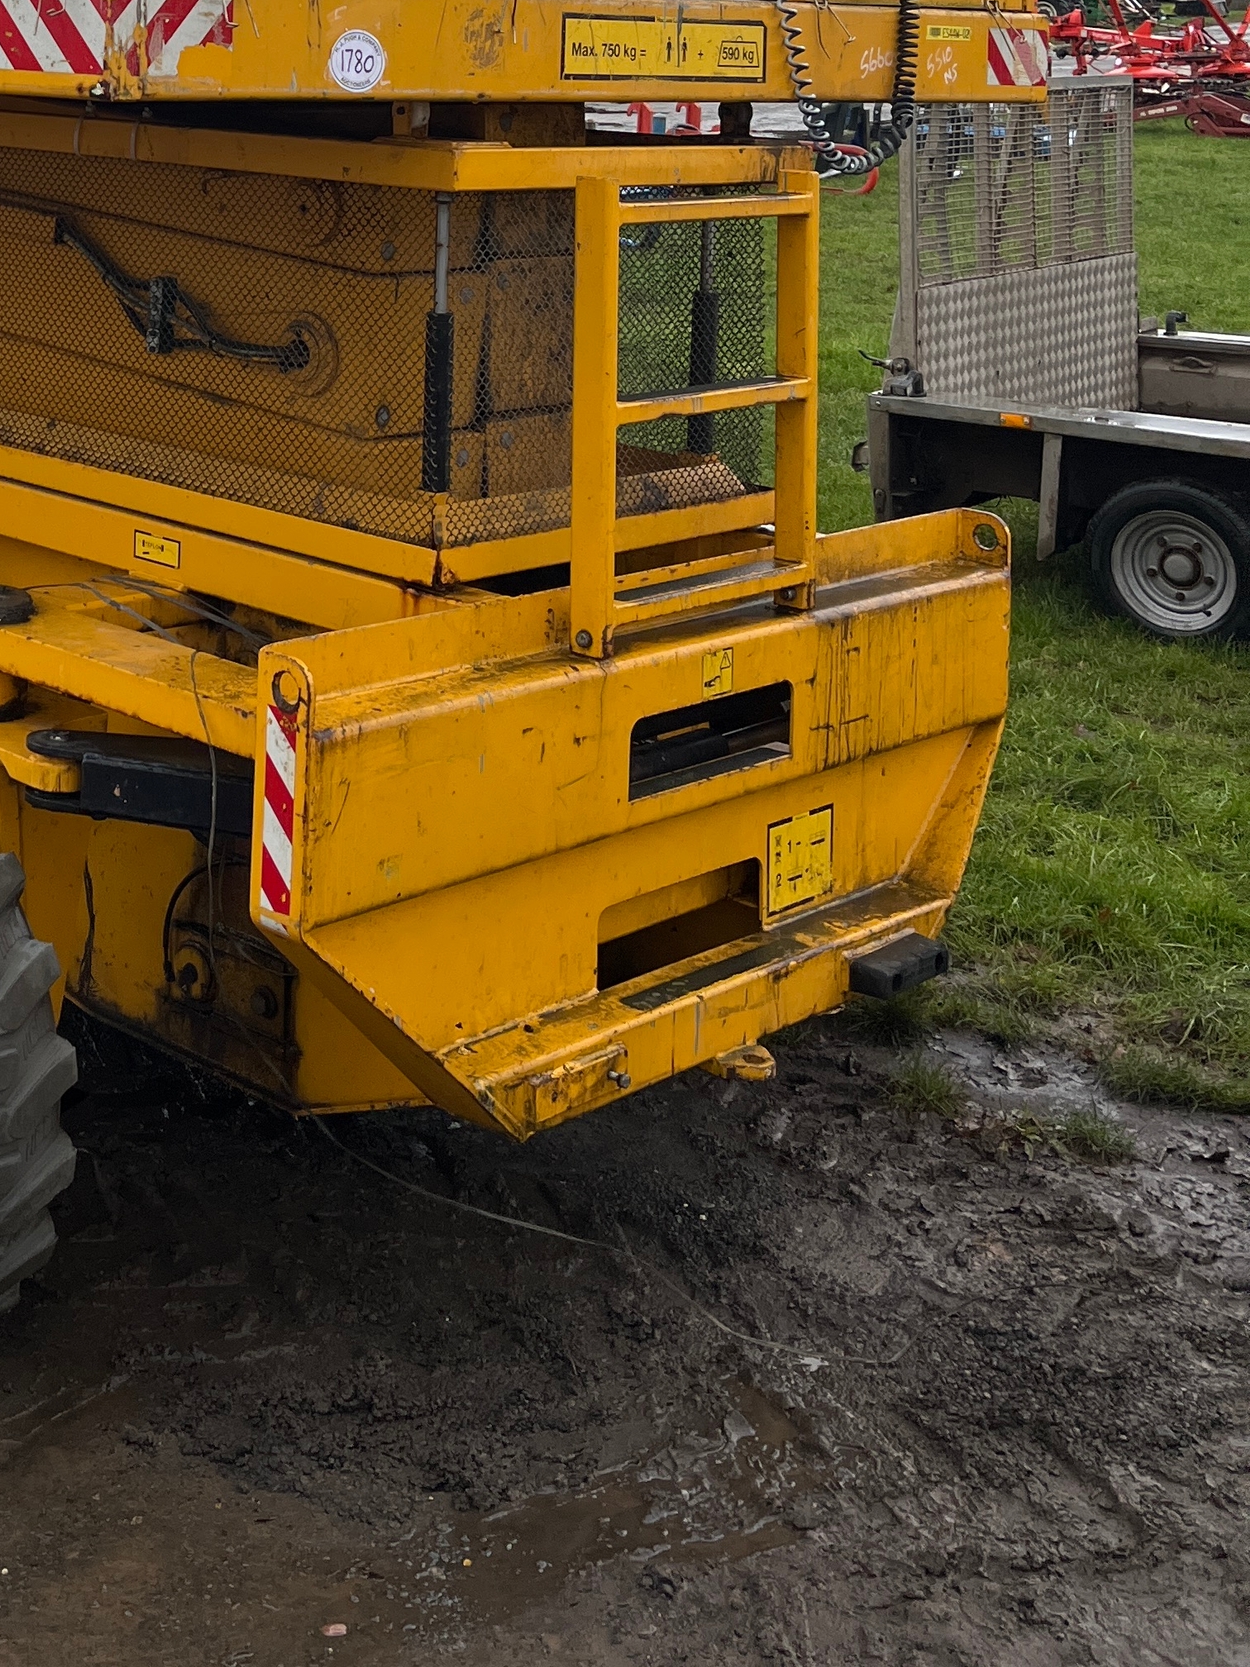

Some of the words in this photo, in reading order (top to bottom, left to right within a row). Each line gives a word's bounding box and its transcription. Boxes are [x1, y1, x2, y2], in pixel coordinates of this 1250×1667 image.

[341, 48, 375, 74] 1780
[571, 42, 598, 57] Max.
[601, 43, 621, 58] 750
[623, 44, 637, 61] kg
[721, 47, 740, 60] 590
[742, 48, 755, 64] kg
